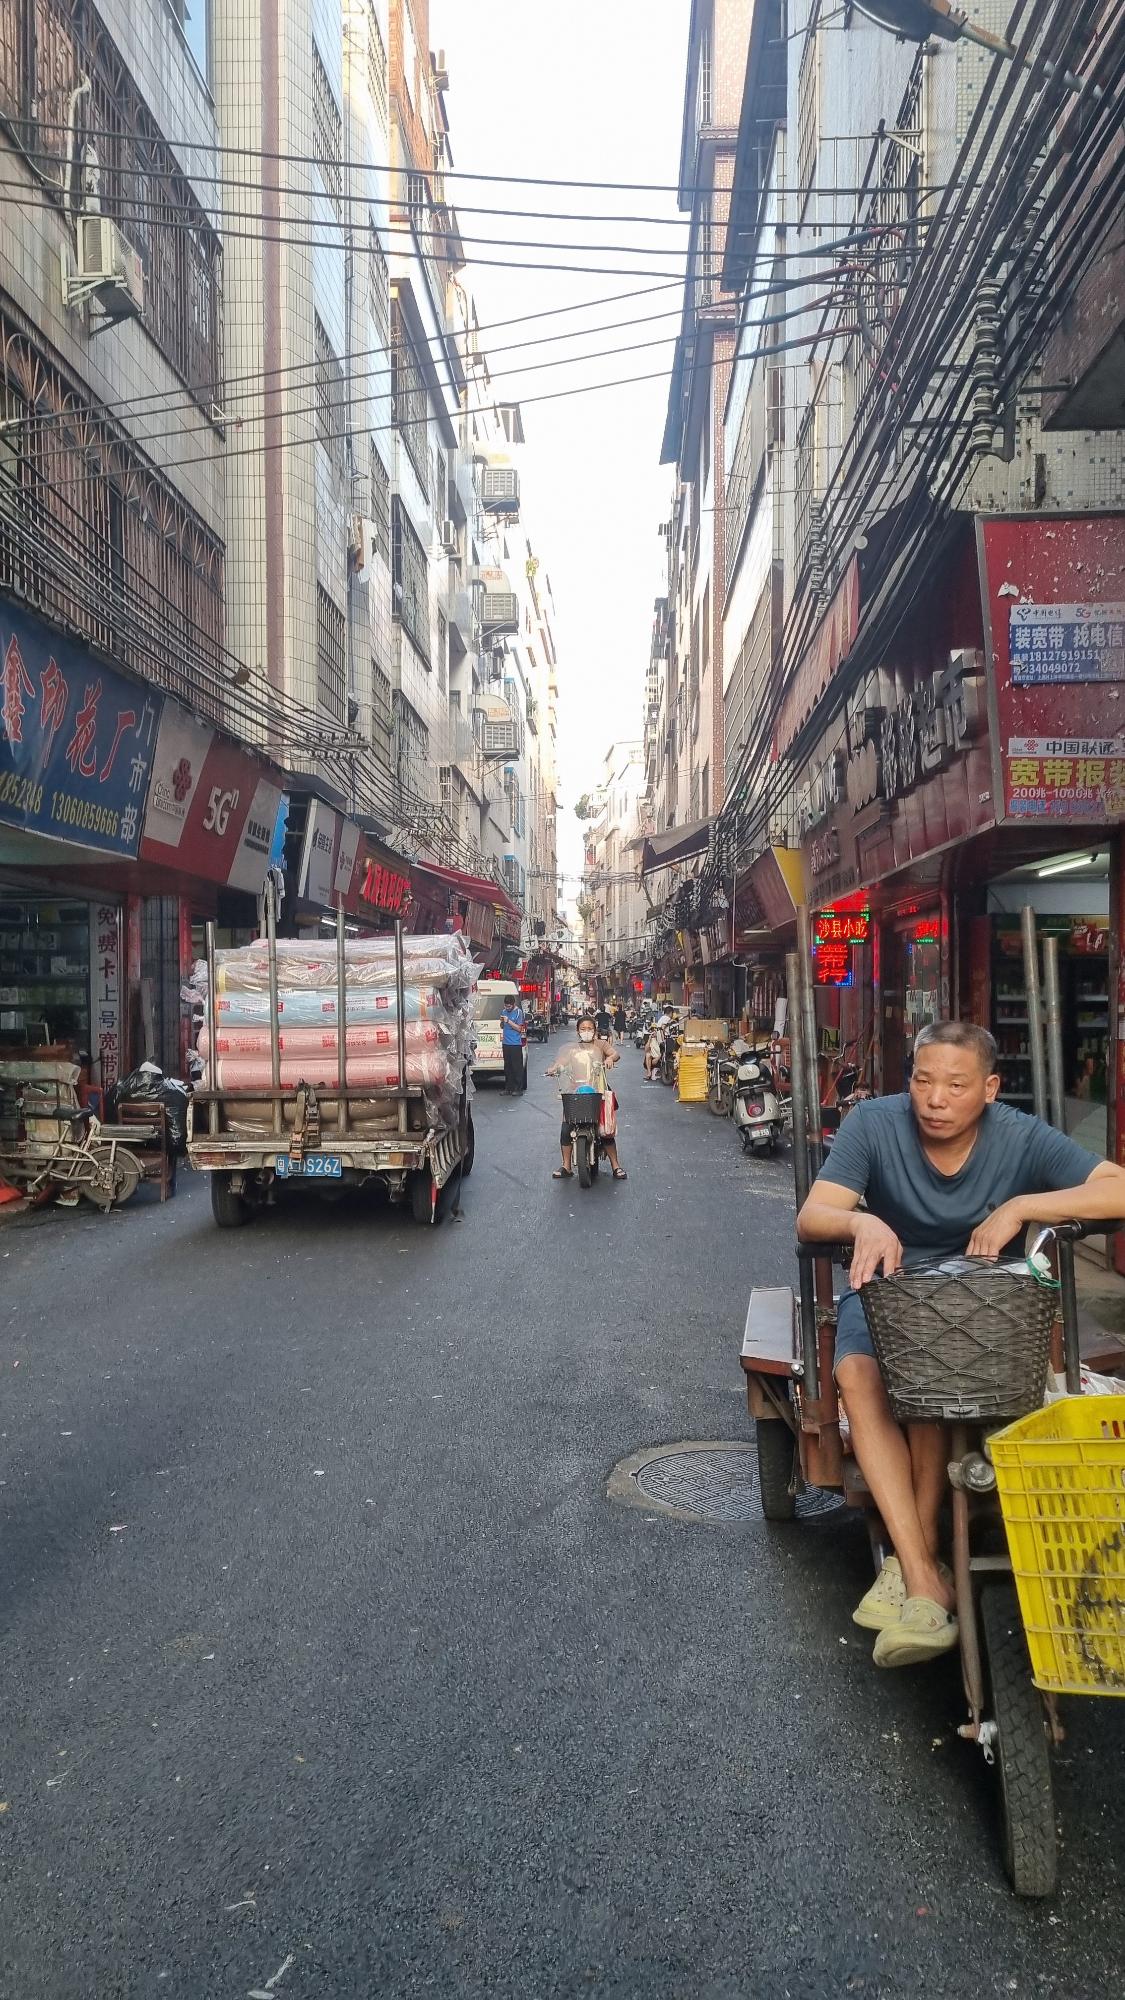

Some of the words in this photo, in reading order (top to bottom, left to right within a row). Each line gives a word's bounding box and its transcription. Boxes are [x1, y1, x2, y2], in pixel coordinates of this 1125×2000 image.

[1075, 607, 1091, 619] 5G
[1015, 626, 1065, 650] 装宽带
[1073, 621, 1124, 649] 找电信
[1046, 741, 1114, 755] 中国联通
[121, 698, 156, 844] 门市部
